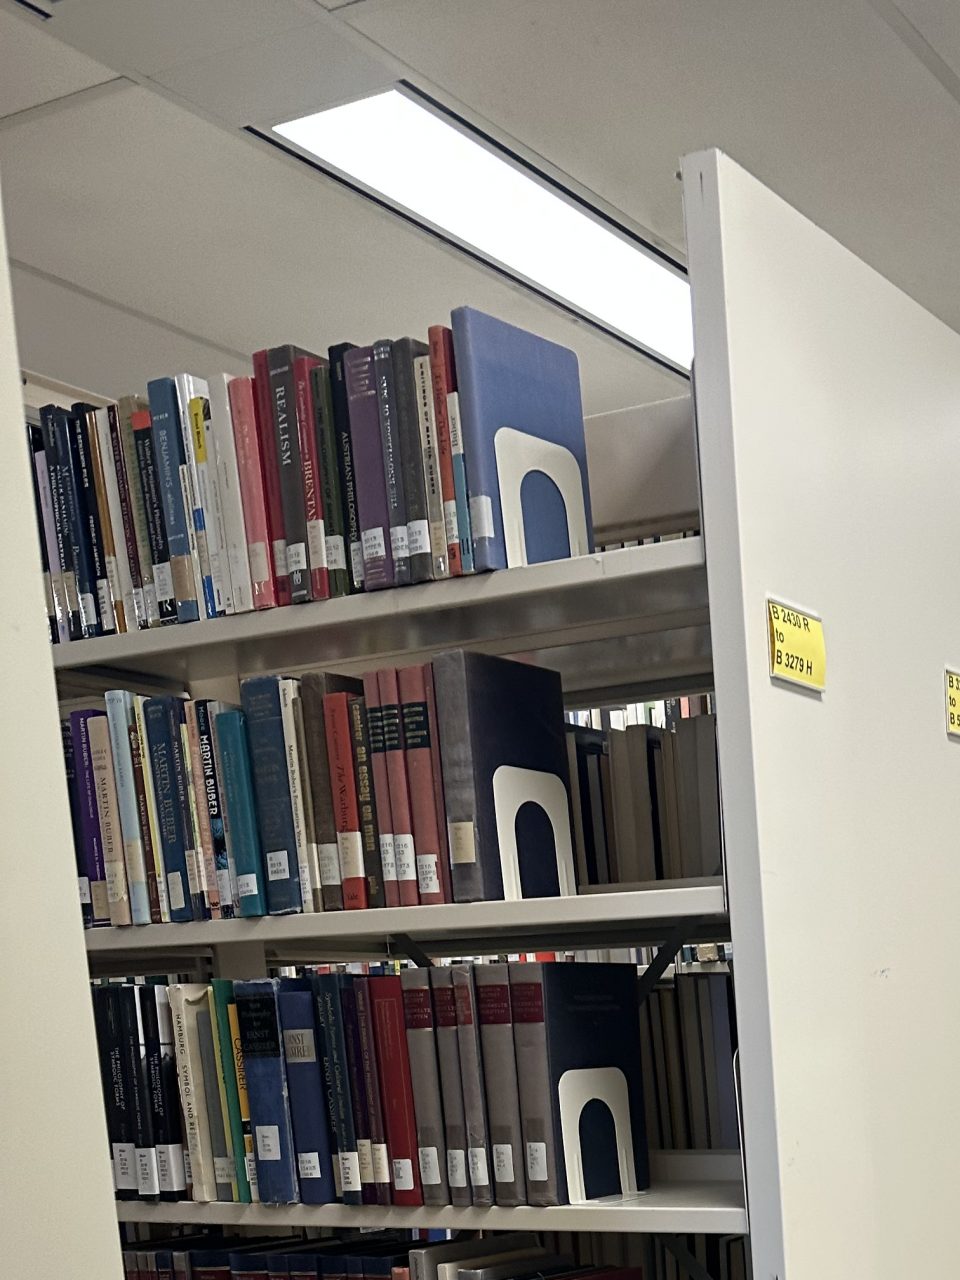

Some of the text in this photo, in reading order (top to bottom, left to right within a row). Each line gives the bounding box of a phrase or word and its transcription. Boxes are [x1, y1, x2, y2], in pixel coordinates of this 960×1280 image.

[274, 386, 292, 464] REALISM
[424, 425, 433, 459] MARTIN
[47, 472, 63, 529] PHILOSOPHICAL
[144, 439, 164, 550] Walter Benjamin's Philosophy
[340, 430, 359, 542] AUSTRIAN PHILOSOPHY
[92, 544, 101, 575] JAMESON
[772, 605, 811, 632] B 2430 R
[776, 627, 784, 644] to
[777, 650, 813, 676] B 3279 H
[948, 676, 954, 688] B
[949, 695, 956, 707] to
[950, 713, 955, 725] B
[78, 717, 86, 741] MARTIN
[172, 740, 185, 801] MARTIN BUBER
[197, 706, 218, 815] Moore MARTIN BUBER
[335, 764, 345, 783] The
[351, 703, 375, 851] cassirer an essay on man
[138, 793, 146, 824] MARTIN
[156, 742, 177, 843] MARTIN BUBER
[292, 794, 301, 827] Formative
[99, 776, 114, 853] MARTIN BUBER
[109, 1051, 117, 1082] SYMBOLIC
[148, 1056, 157, 1087] SYMBOLIC
[174, 1014, 185, 1054] HAMBURG
[181, 1064, 190, 1097] SYMBOL
[232, 1038, 247, 1090] CASSIRER
[115, 1059, 124, 1098] PHILOSOPHY
[120, 1100, 125, 1110] OF
[153, 1066, 163, 1105] PHILOSOPHY
[158, 1107, 163, 1116] OF
[322, 1055, 337, 1132] ERNST CASSIRER
